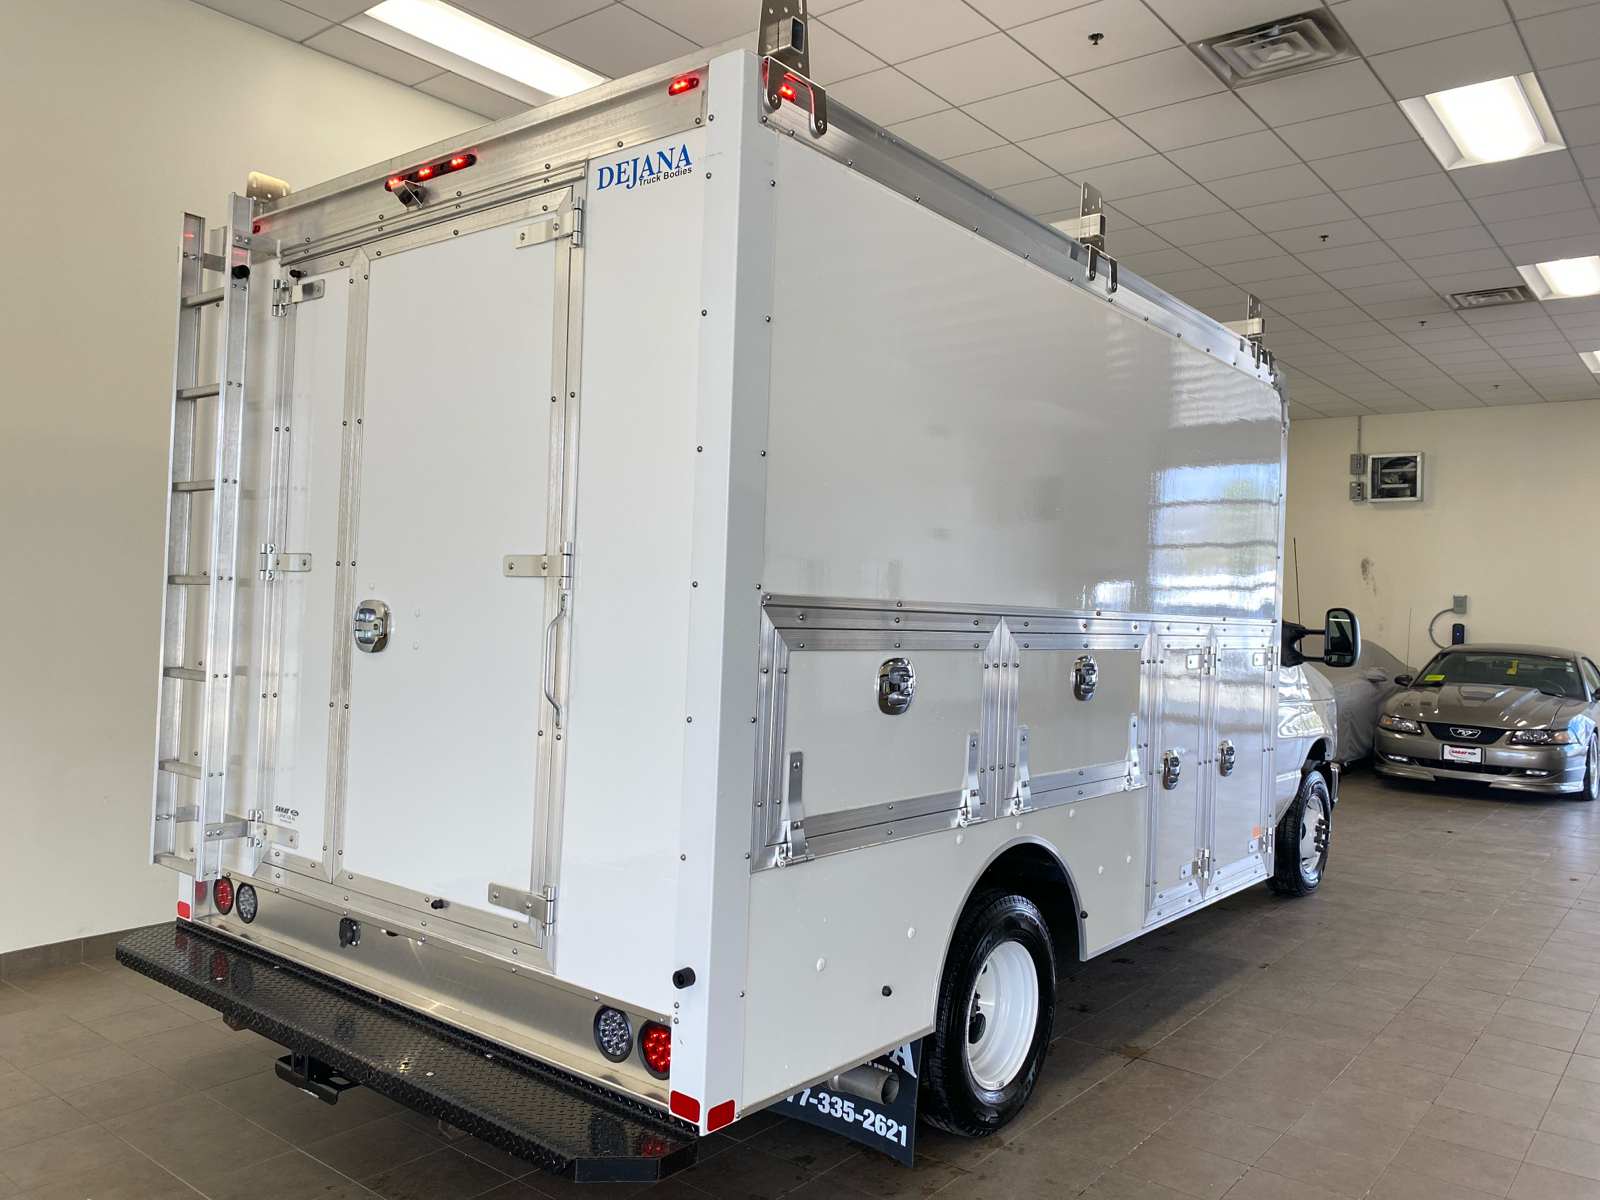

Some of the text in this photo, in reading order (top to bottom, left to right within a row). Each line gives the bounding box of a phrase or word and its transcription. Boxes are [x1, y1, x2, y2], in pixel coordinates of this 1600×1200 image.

[596, 143, 692, 191] DEJANA
[638, 166, 692, 187] Truck Bodies
[886, 1042, 918, 1079] A
